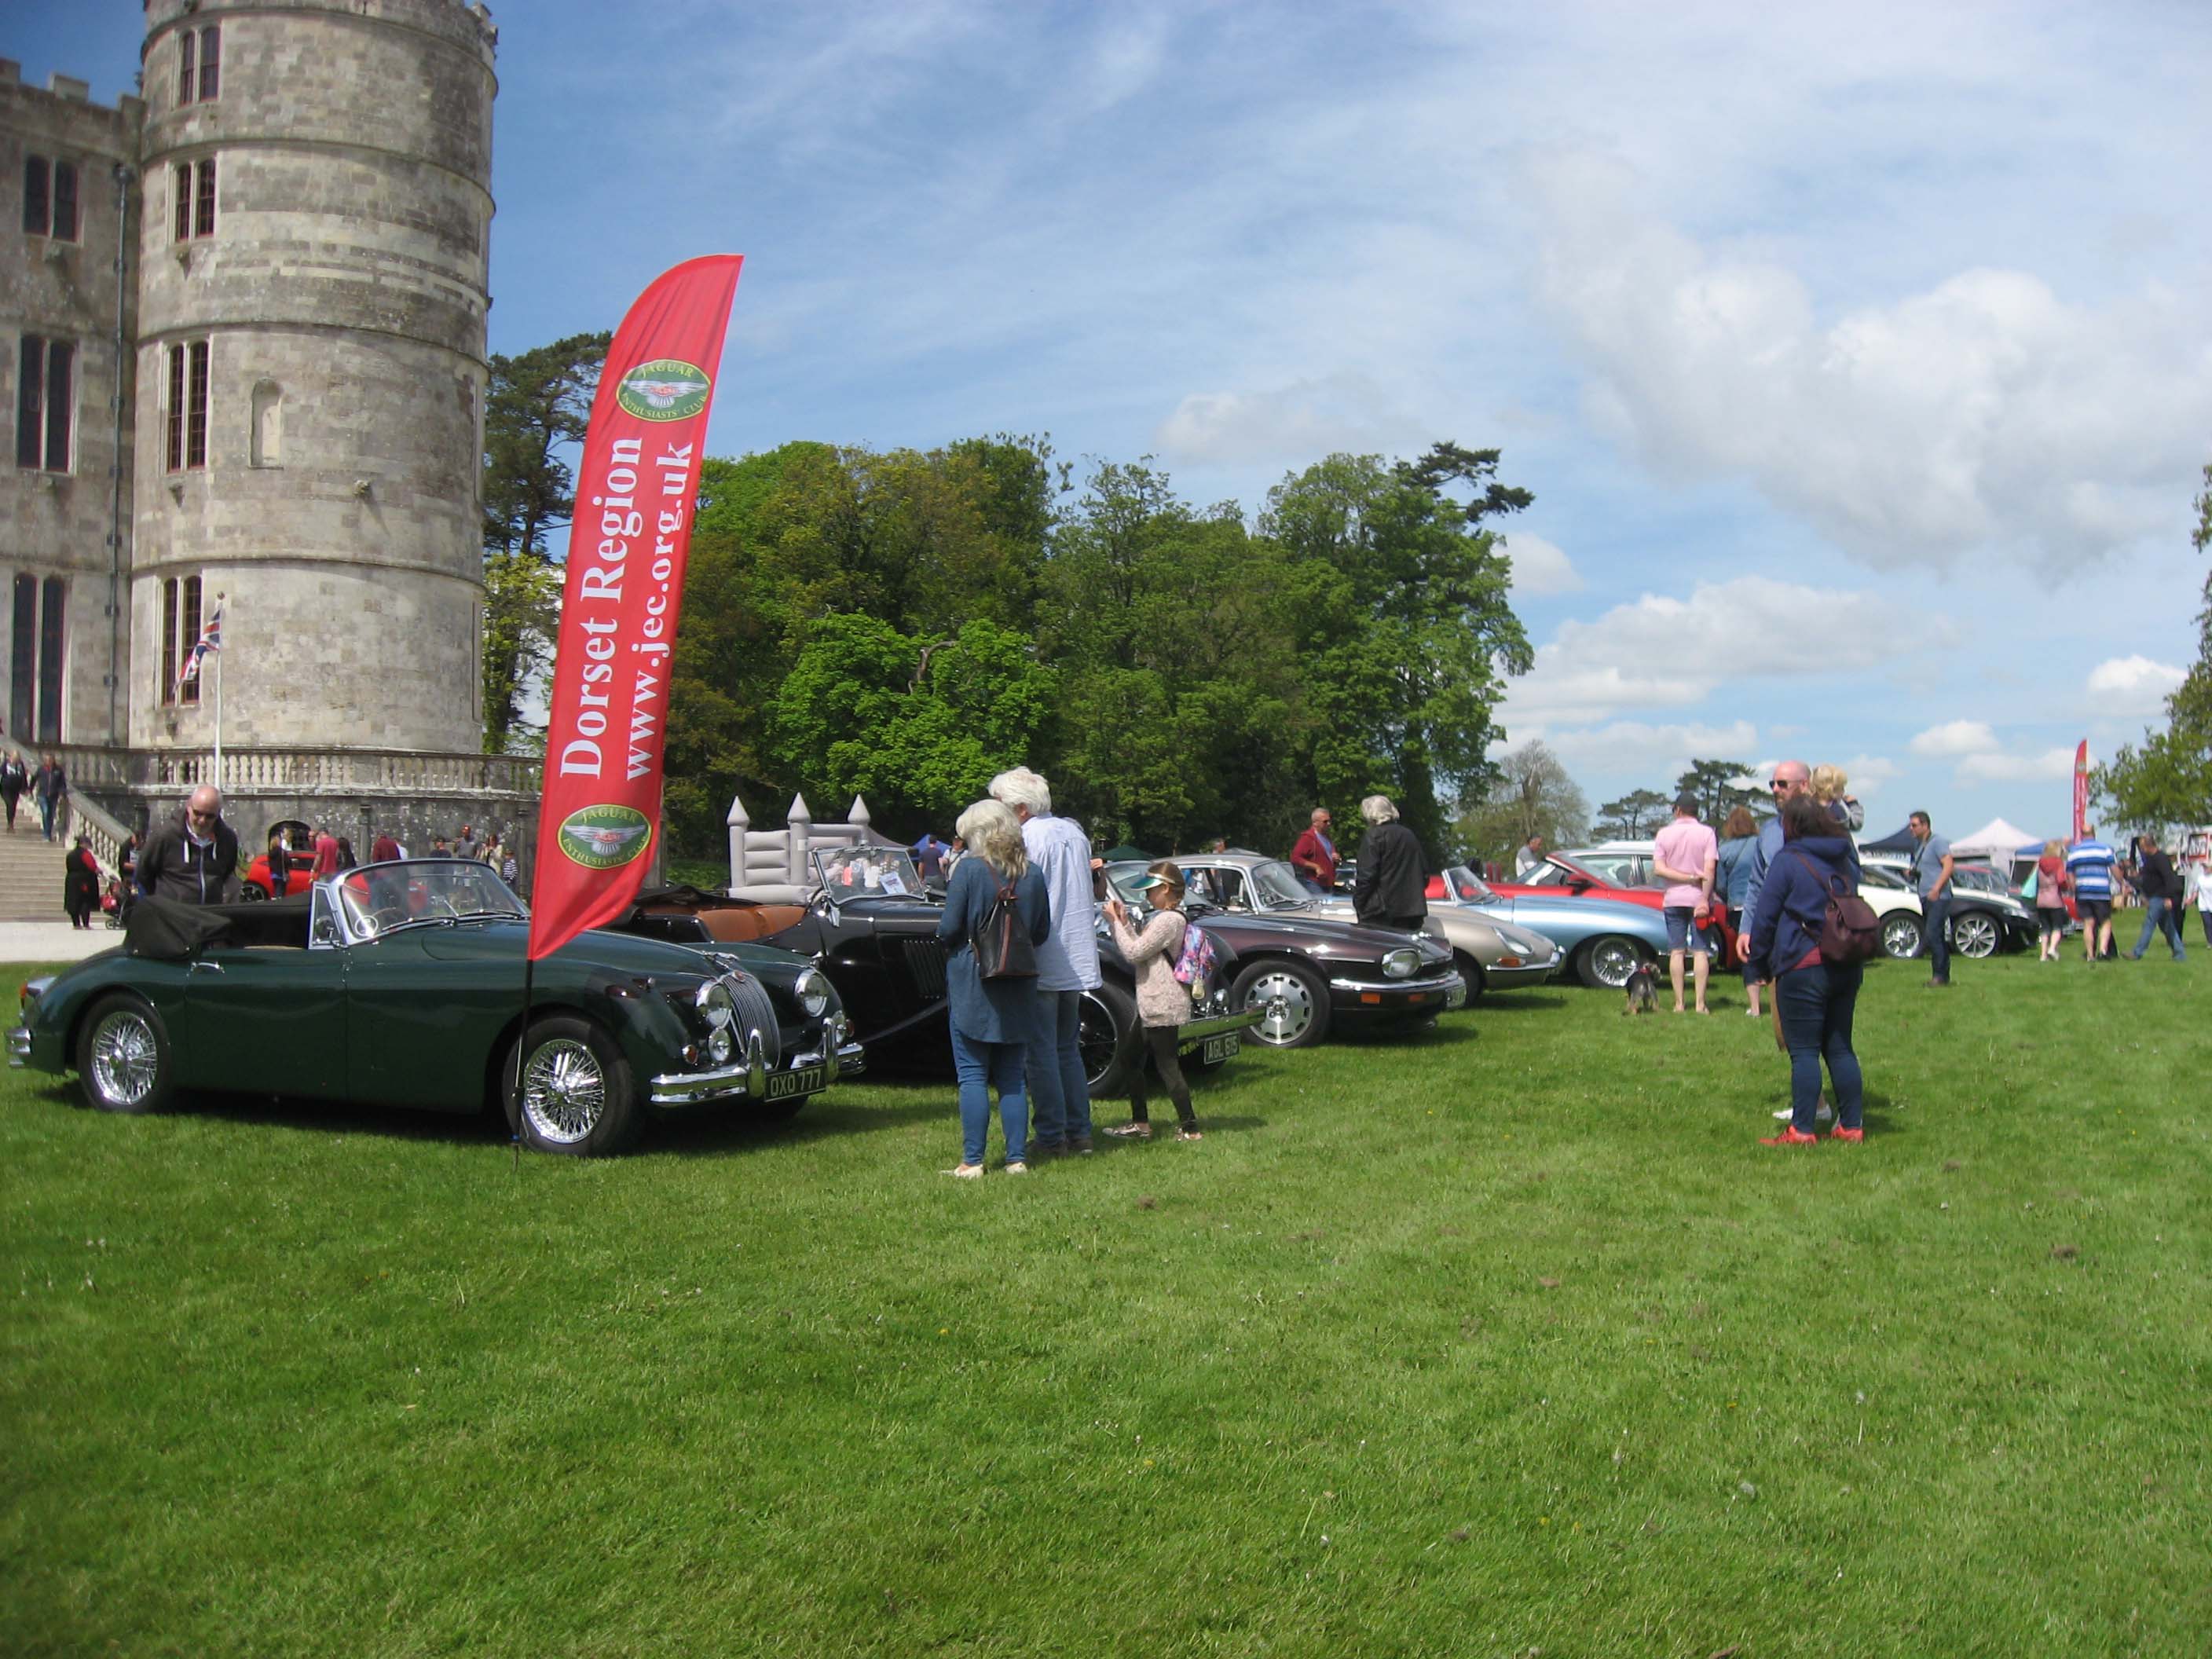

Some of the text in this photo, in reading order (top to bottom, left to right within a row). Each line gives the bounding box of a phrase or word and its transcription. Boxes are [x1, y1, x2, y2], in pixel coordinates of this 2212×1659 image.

[641, 362, 694, 378] JAGUAR
[560, 438, 643, 780] Dorset Region
[627, 441, 694, 781] www.jec.org.uk
[582, 807, 638, 823] JAGUAR
[1207, 1041, 1224, 1060] AGL
[770, 1068, 821, 1097] OXO 777
